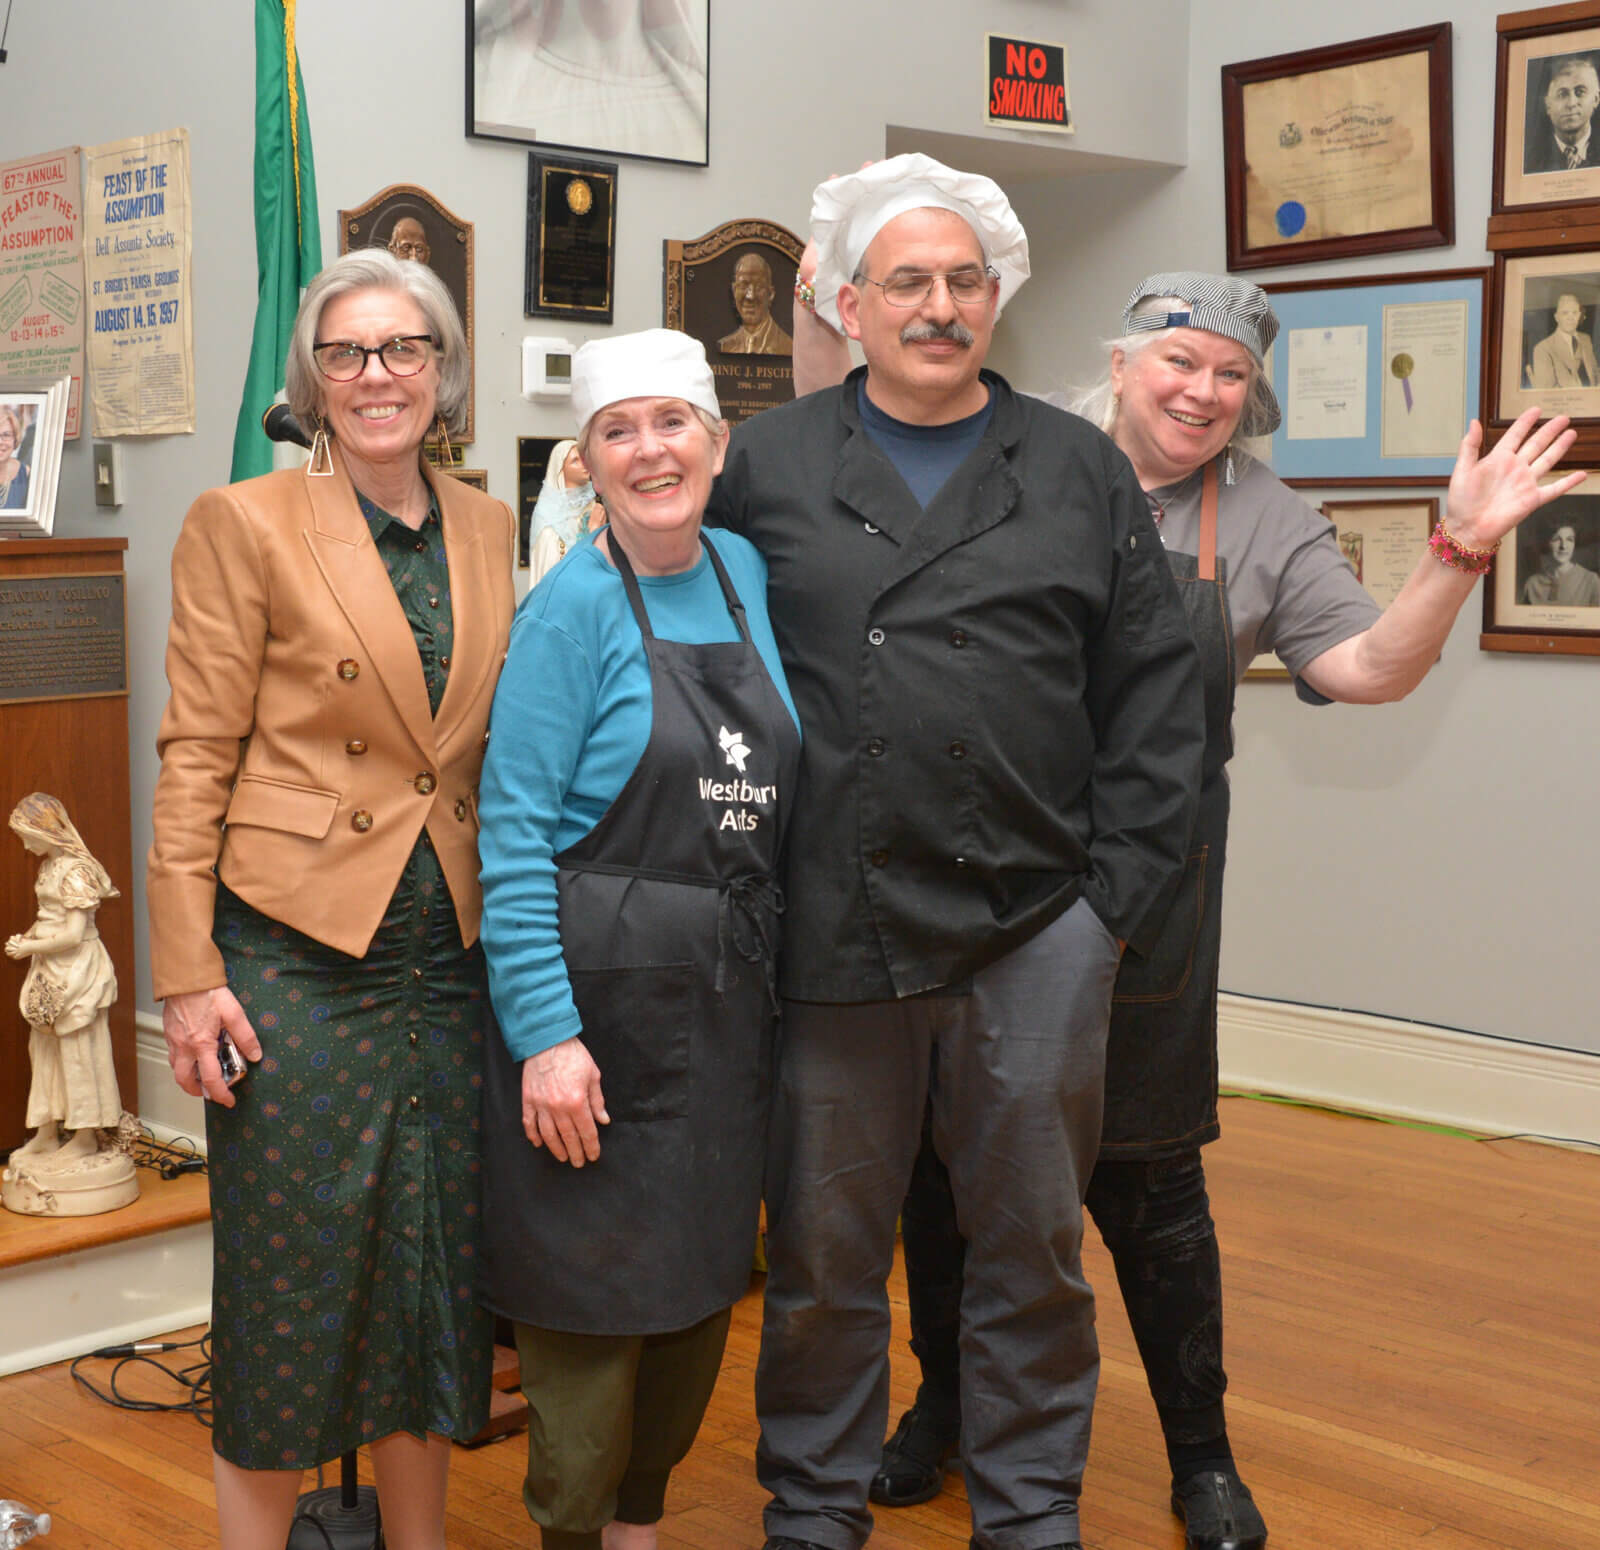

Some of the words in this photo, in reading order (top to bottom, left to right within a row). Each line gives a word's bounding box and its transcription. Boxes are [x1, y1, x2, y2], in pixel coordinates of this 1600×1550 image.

[1006, 43, 1047, 79] NO
[990, 76, 1064, 121] SMOKING
[26, 164, 64, 185] ANNUAL
[104, 170, 133, 198] FEAST
[136, 168, 148, 192] OF
[151, 163, 168, 189] THE
[1, 191, 35, 229] FEAST
[38, 190, 50, 208] OF
[52, 193, 73, 221] THE
[105, 191, 165, 225] ASSUMPTION
[1, 224, 74, 251] ASSUMPTION
[145, 229, 175, 250] Society
[23, 314, 51, 327] AUGUST
[95, 305, 131, 333] AUGUST
[159, 298, 179, 325] 1957
[755, 366, 793, 379] PISCIT
[719, 808, 759, 831] Arts
